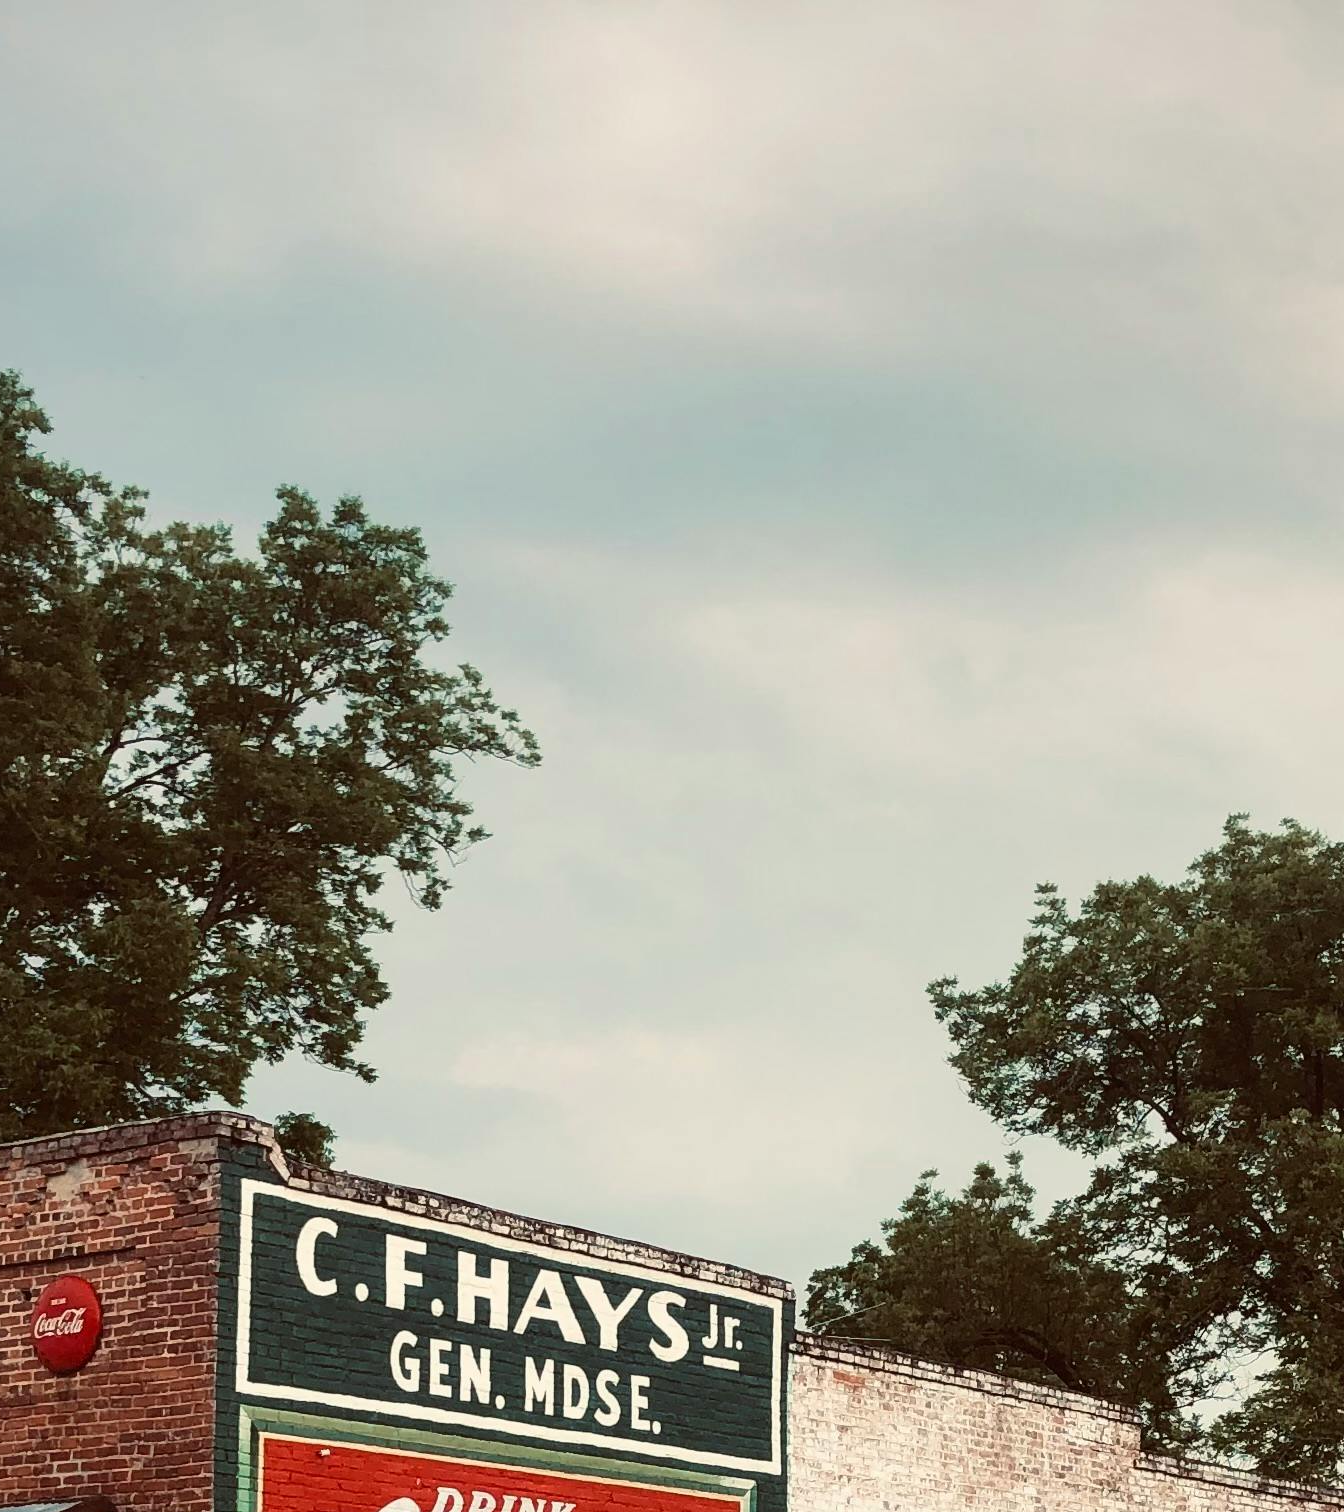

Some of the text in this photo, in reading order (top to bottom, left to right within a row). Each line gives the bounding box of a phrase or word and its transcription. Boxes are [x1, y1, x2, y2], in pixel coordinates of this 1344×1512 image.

[34, 1307, 87, 1339] Coca-Cola
[389, 1330, 663, 1436] GEN. MDSE.
